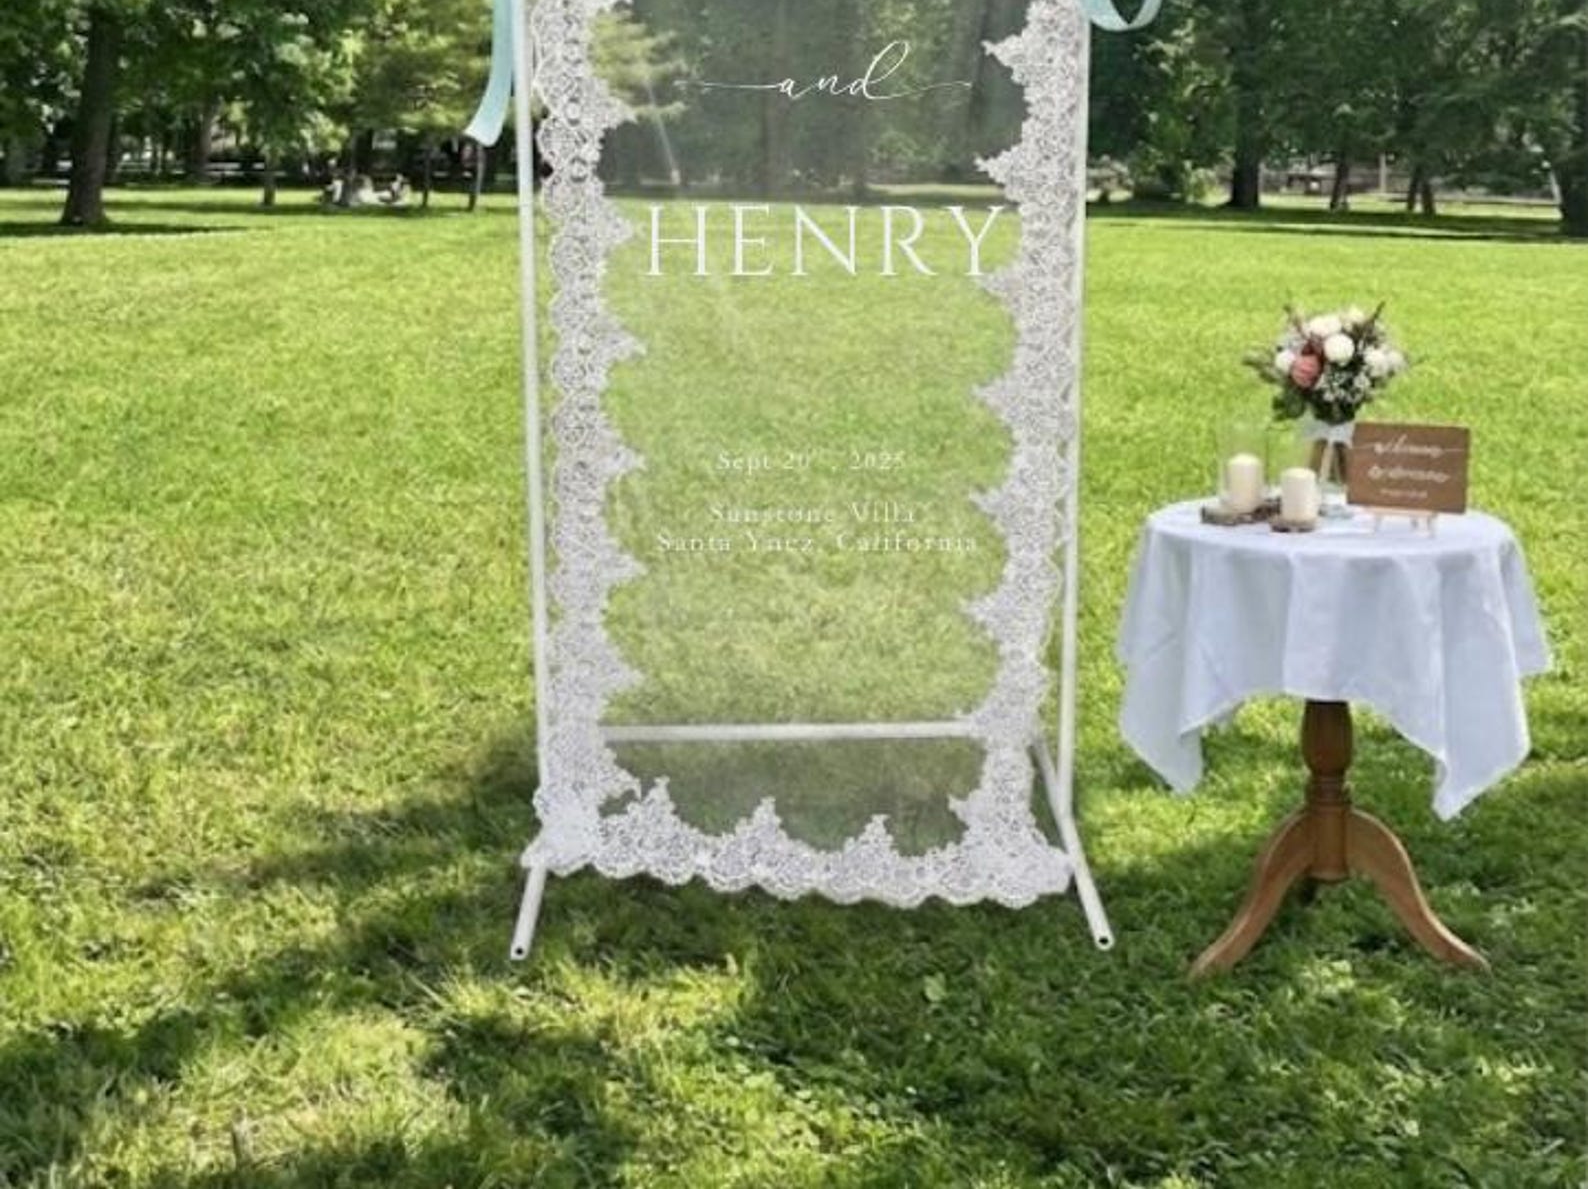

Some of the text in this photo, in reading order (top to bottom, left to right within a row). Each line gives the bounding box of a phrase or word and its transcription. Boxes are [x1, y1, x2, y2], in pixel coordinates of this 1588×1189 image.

[646, 205, 1006, 277] HENRY
[716, 449, 772, 475] Sept
[848, 501, 915, 523] Villa
[656, 527, 731, 552] Santa
[836, 529, 978, 553] California
